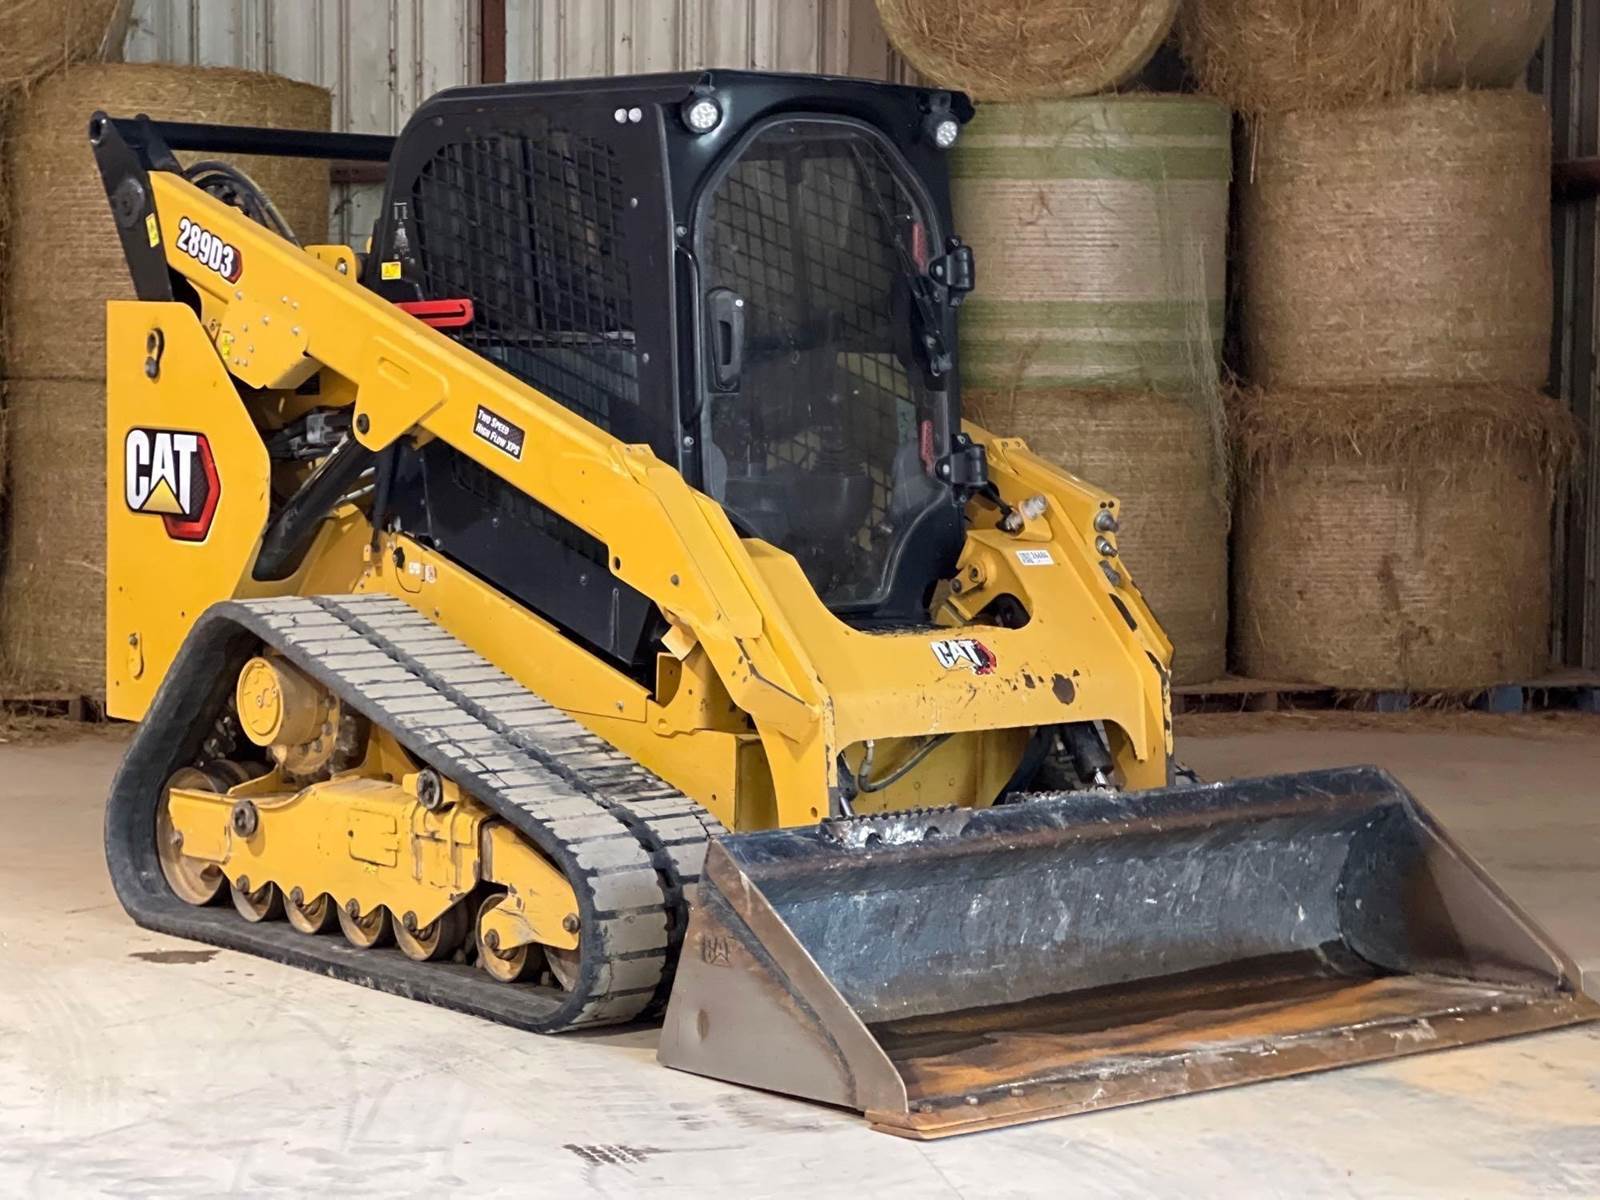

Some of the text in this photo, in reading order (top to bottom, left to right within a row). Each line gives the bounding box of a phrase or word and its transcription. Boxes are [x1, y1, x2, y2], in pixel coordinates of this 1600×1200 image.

[177, 217, 234, 278] 289D3
[505, 440, 520, 455] XPS
[126, 429, 198, 515] CAT
[930, 640, 982, 669] CAT
